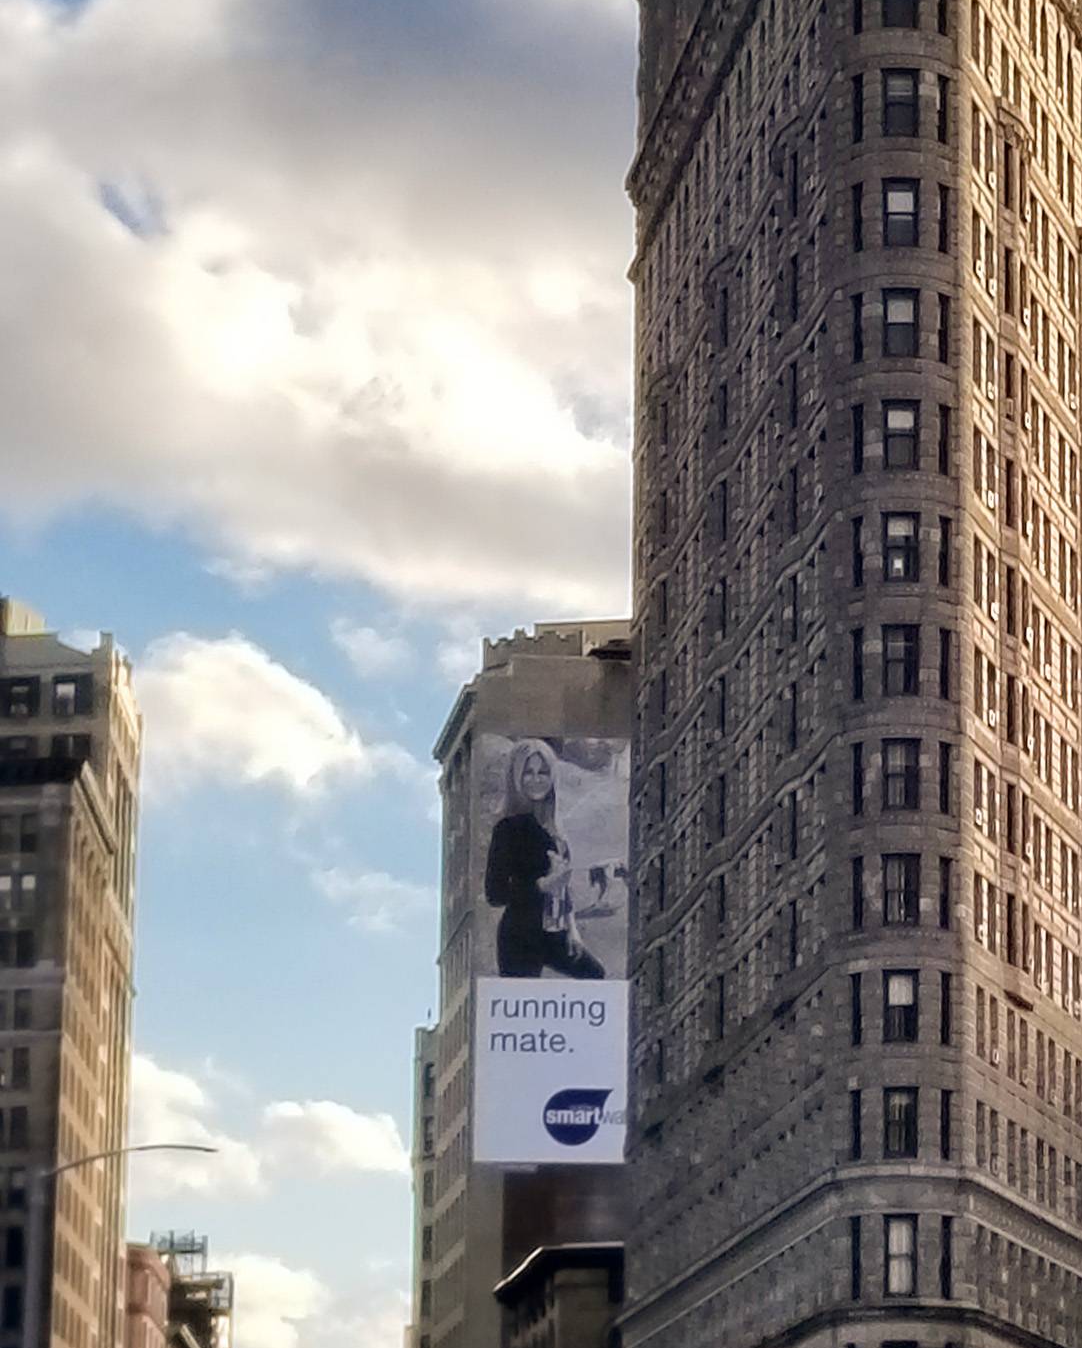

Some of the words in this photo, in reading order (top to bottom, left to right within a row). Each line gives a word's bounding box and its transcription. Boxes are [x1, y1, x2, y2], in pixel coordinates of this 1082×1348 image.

[489, 993, 606, 1027] running
[489, 1028, 575, 1053] mate.
[546, 1106, 626, 1125] smartwa
